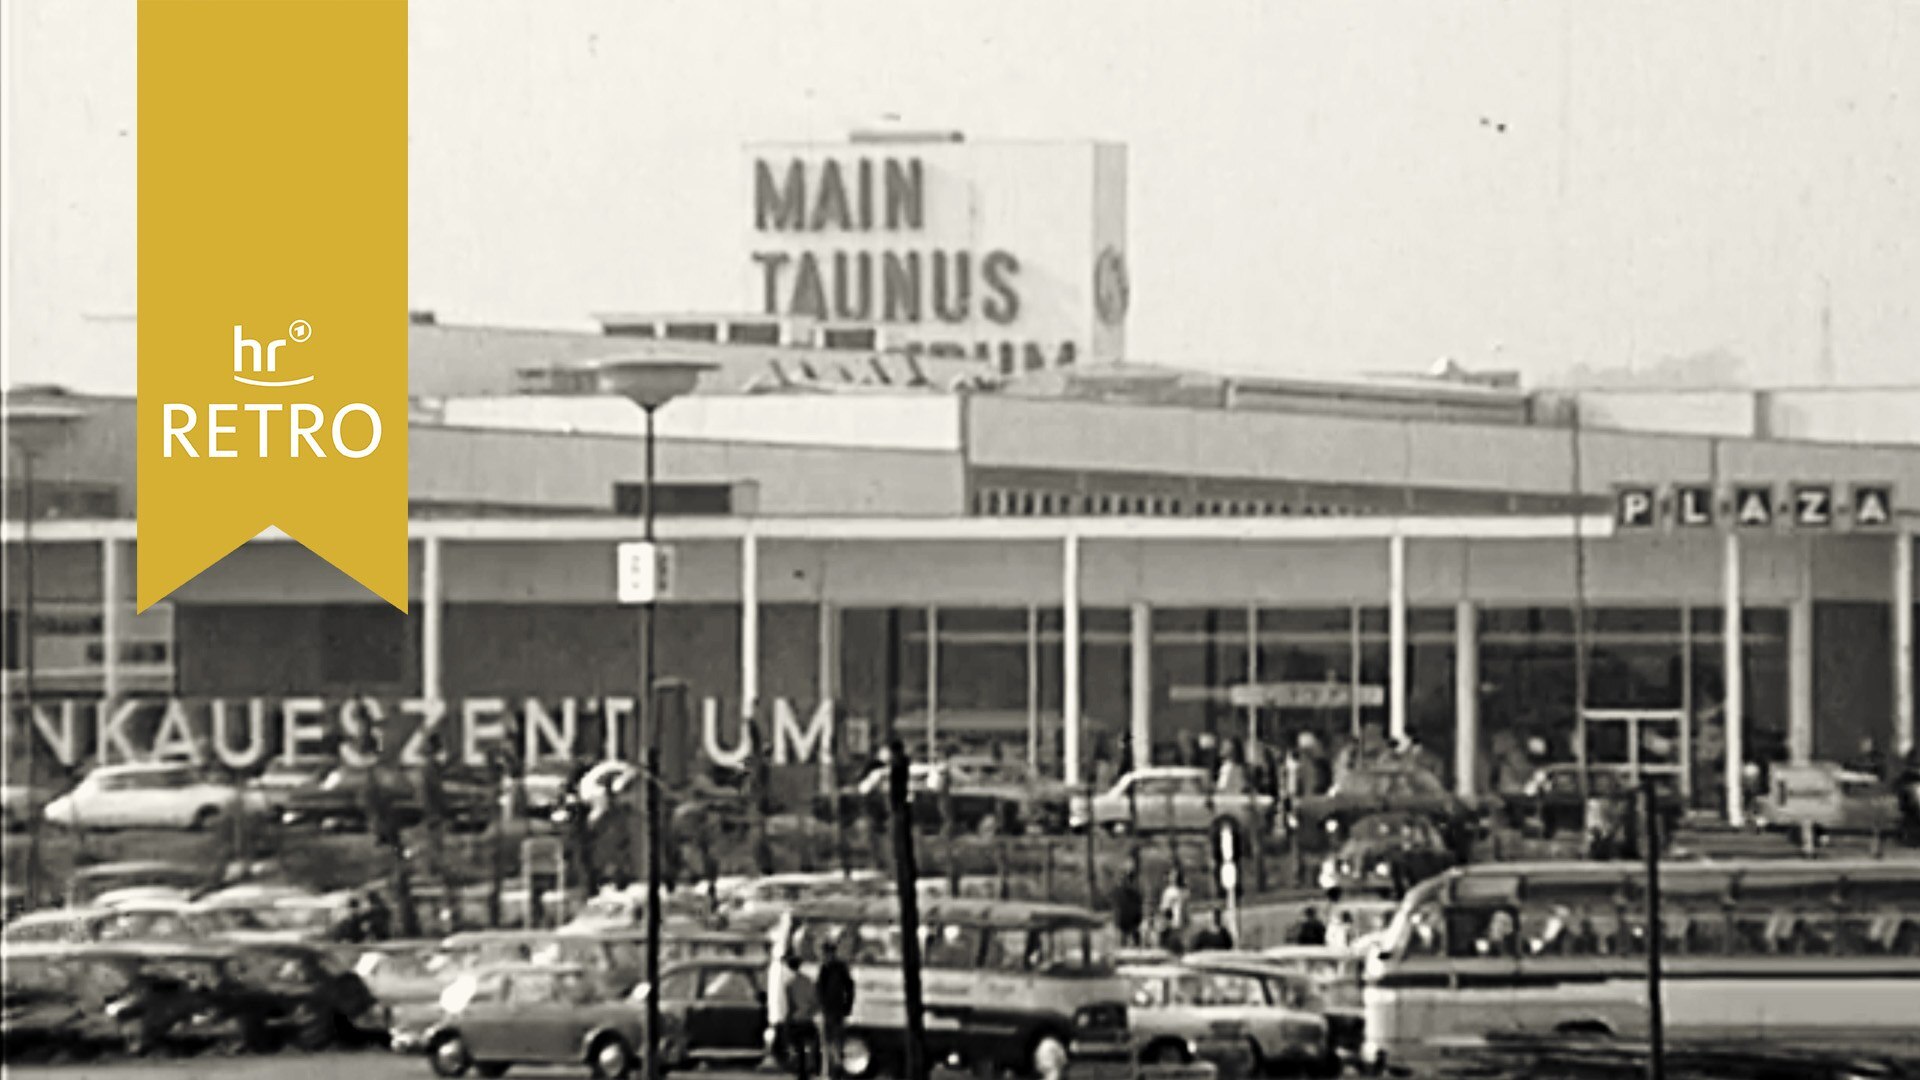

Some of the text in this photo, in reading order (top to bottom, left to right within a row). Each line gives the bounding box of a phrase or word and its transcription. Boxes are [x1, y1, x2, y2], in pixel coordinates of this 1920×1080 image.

[754, 157, 924, 231] MAIN
[751, 249, 1020, 324] TAUNUS
[1625, 491, 1887, 523] PLAZA
[32, 697, 835, 767] NKAUFSZENTUM
